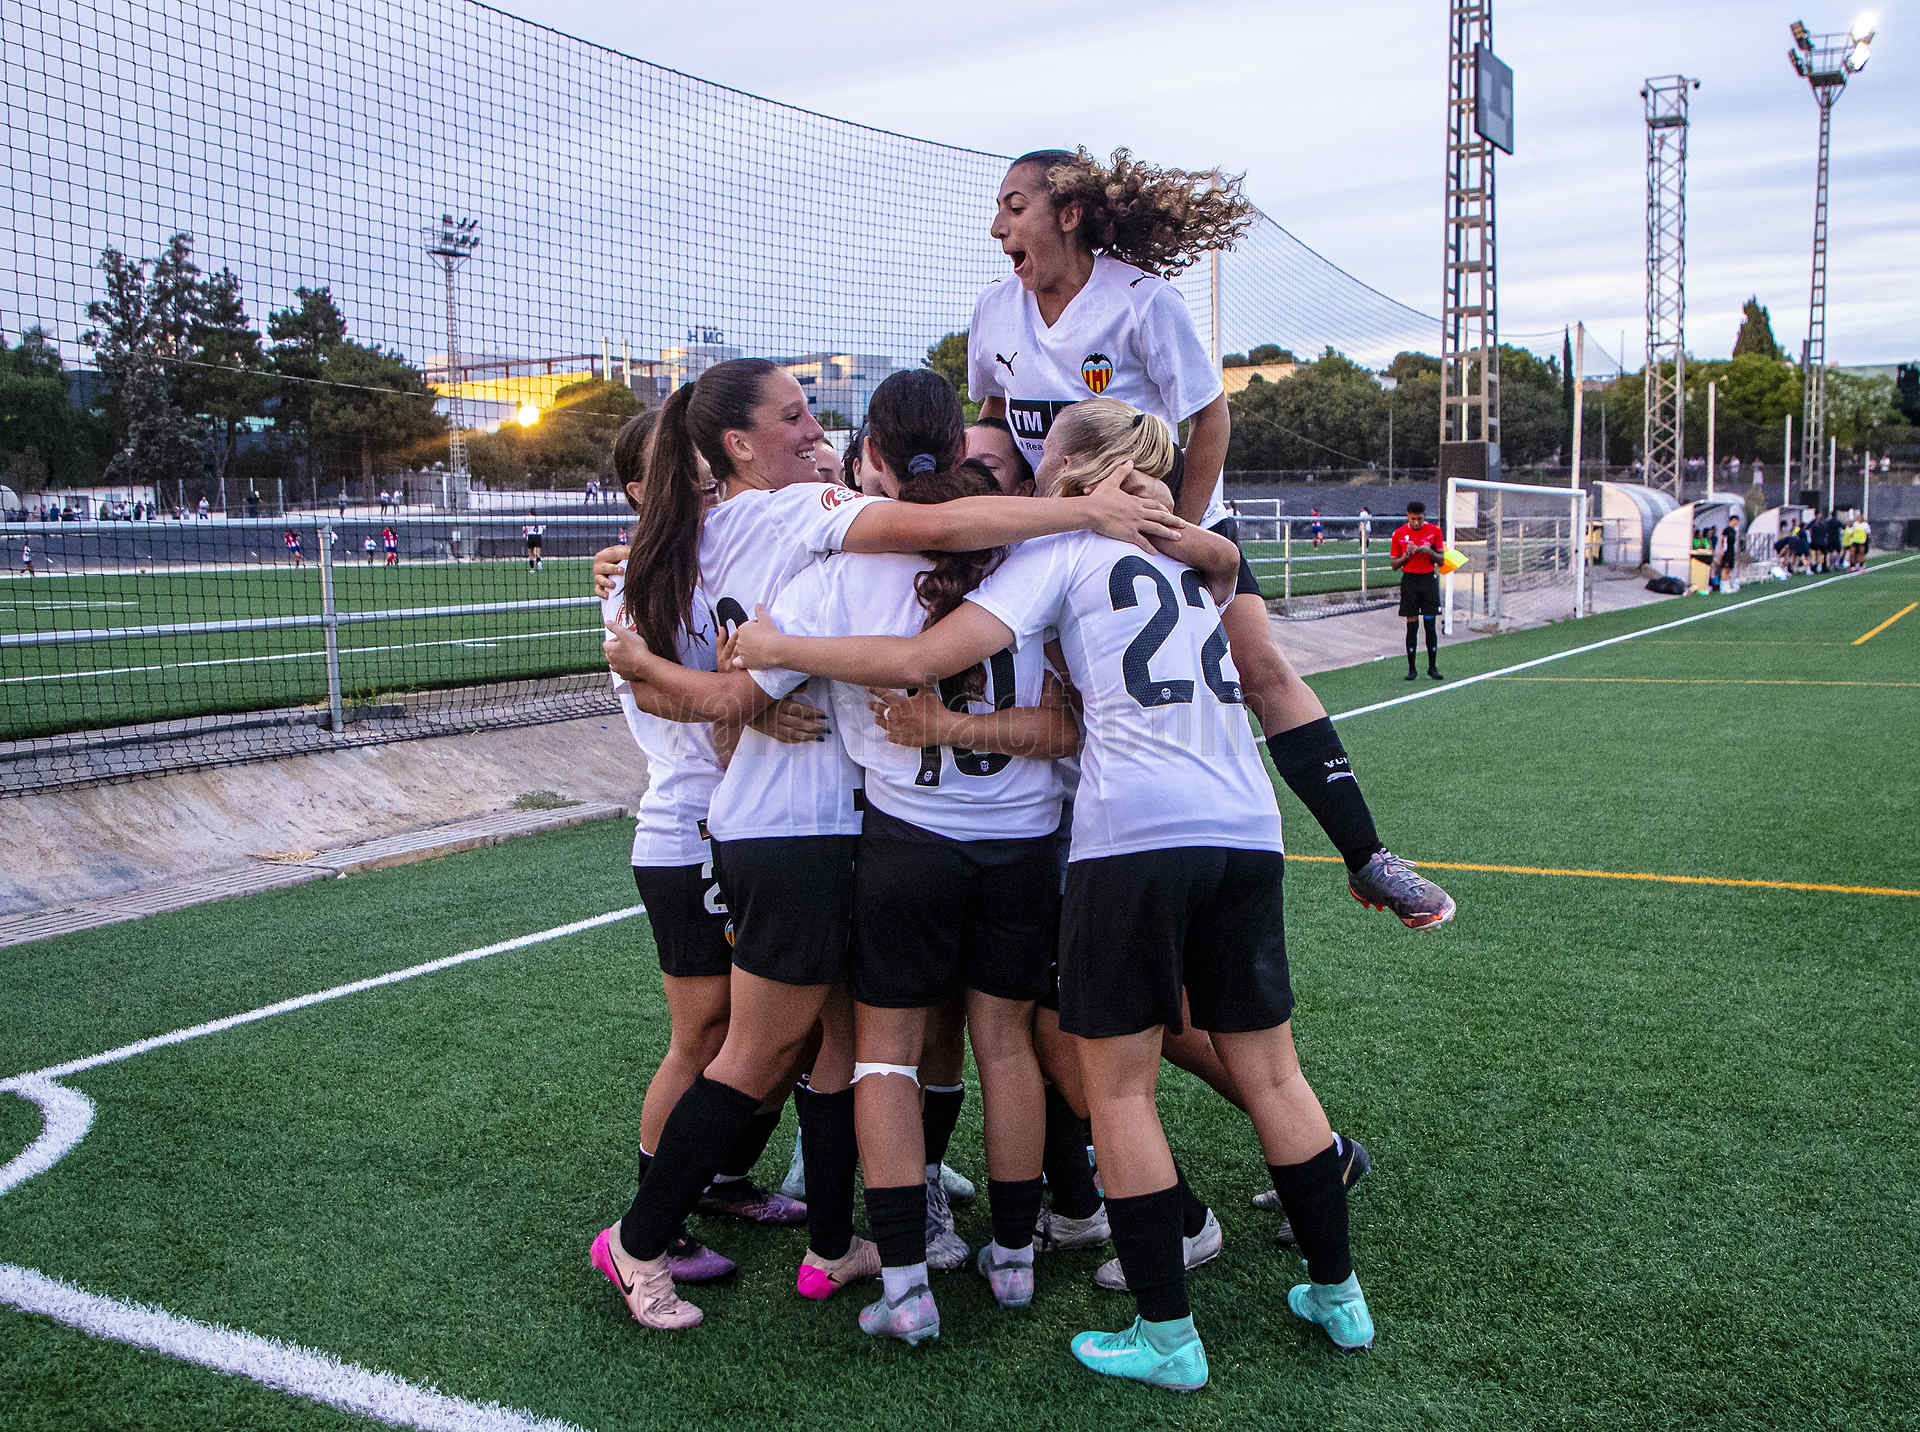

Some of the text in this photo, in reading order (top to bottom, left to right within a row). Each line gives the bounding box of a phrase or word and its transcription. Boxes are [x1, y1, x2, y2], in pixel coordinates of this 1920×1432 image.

[1011, 409, 1043, 433] TM
[1026, 442, 1043, 451] Rea
[1108, 555, 1243, 708] 22
